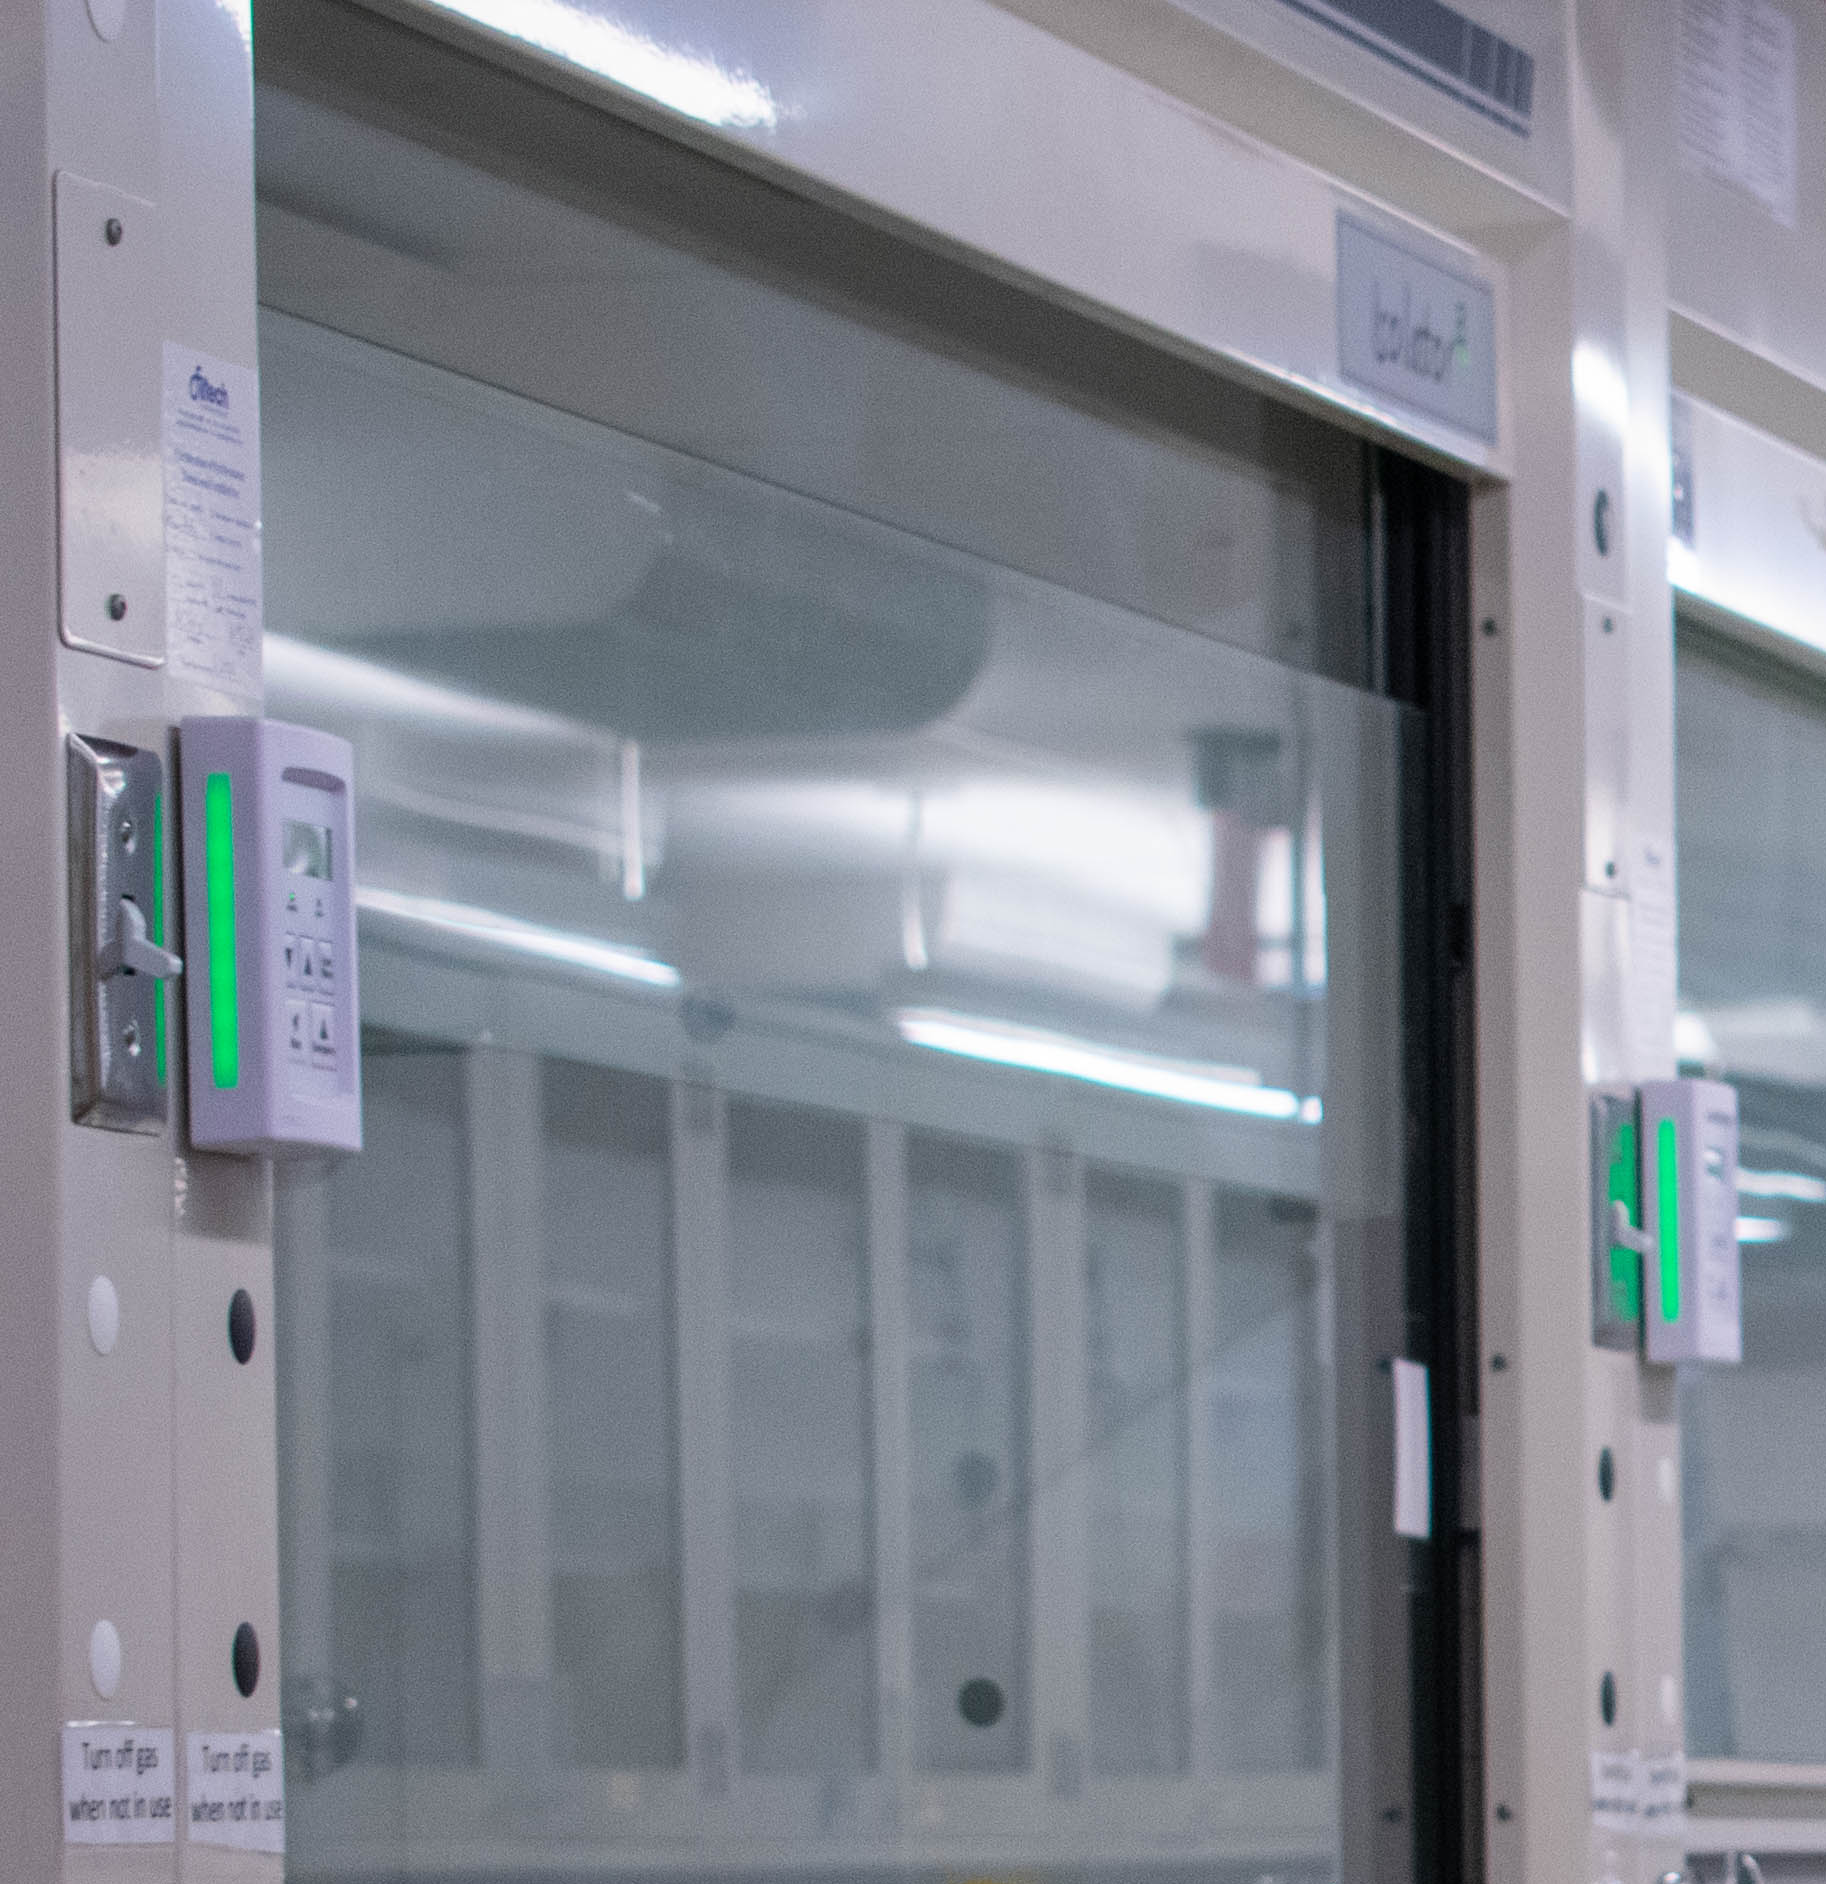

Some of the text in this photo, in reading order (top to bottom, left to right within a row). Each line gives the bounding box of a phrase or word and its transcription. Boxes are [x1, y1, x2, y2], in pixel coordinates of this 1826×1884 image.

[81, 1738, 159, 1776] Turn off gas
[69, 1793, 105, 1822] when
[191, 1795, 225, 1823] when
